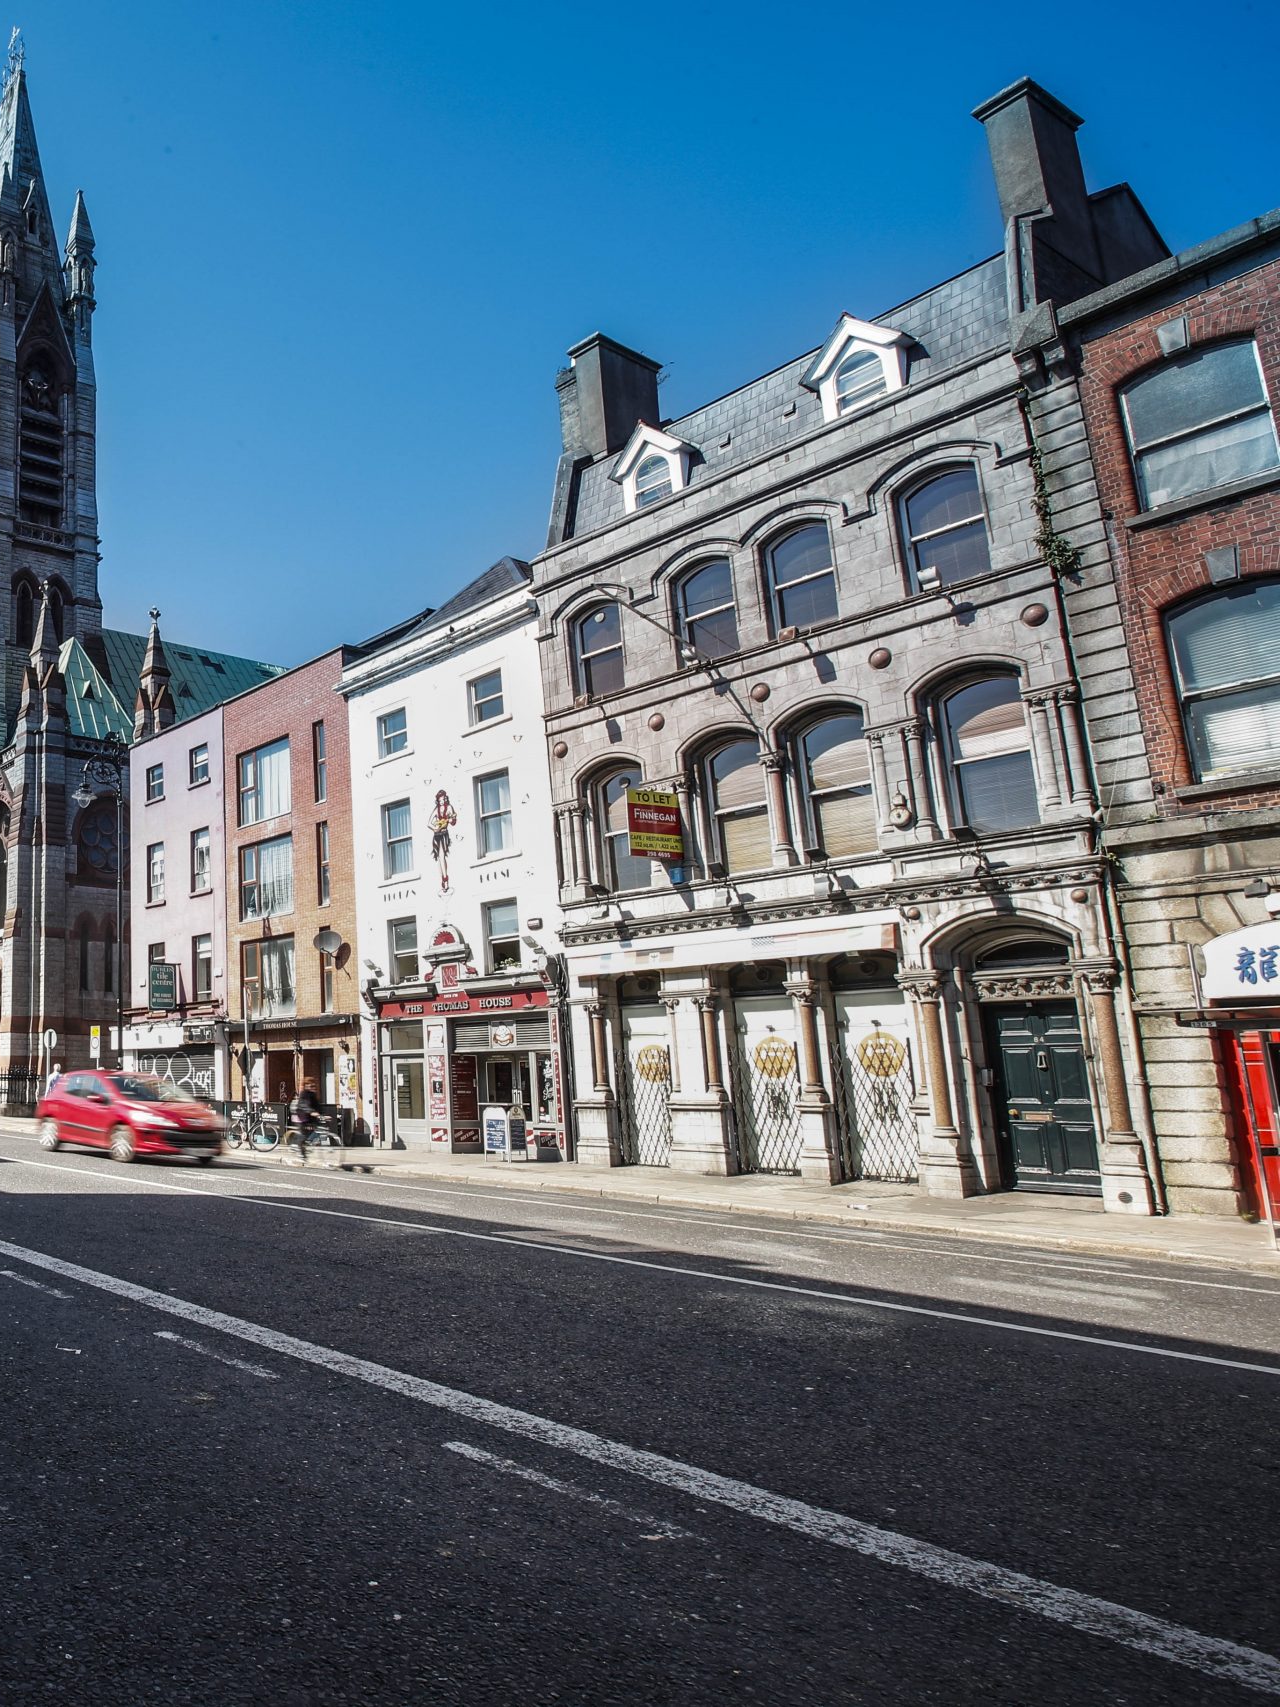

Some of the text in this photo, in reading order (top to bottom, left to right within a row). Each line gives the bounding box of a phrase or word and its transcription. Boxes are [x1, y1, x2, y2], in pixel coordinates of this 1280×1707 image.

[636, 792, 671, 805] TO LET
[156, 971, 169, 980] tile
[405, 997, 513, 1015] THE THOMAS HOUSE
[262, 1022, 282, 1030] THOMAS
